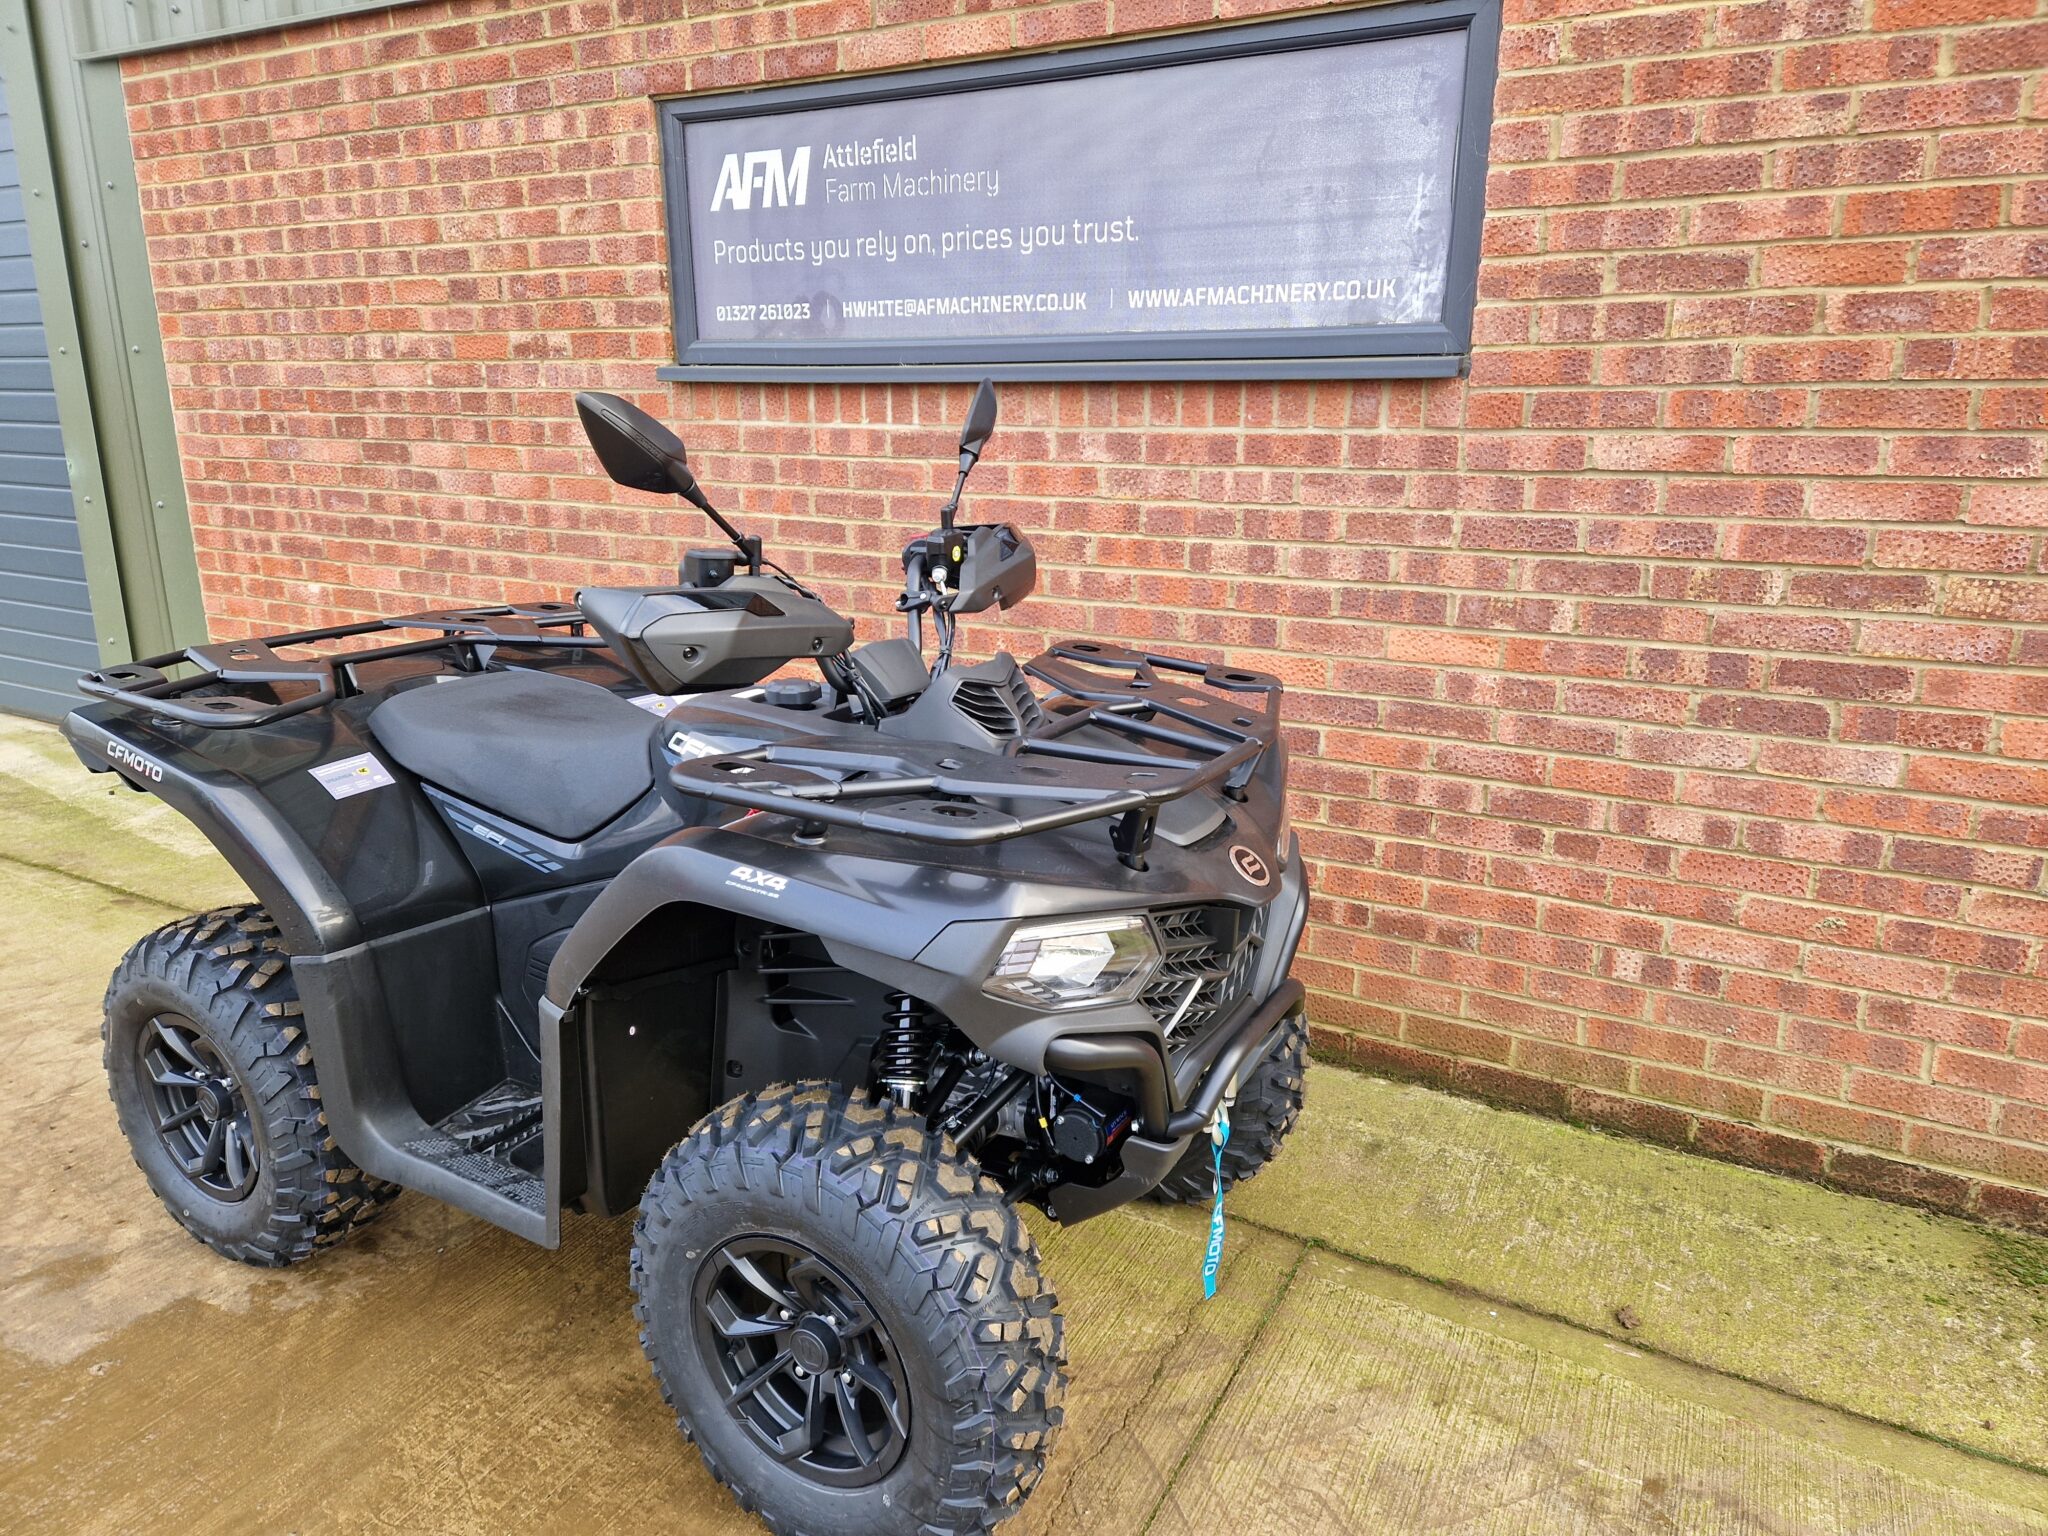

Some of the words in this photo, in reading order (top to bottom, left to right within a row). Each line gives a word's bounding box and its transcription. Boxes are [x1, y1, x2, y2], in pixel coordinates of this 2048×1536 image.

[823, 135, 917, 169] Attlefield
[710, 146, 811, 211] AFM
[825, 178, 876, 203] Farm
[883, 166, 999, 199] Machinery
[713, 239, 805, 264] Products
[811, 239, 850, 265] you
[856, 230, 897, 262] rely
[904, 233, 936, 256] on,
[941, 224, 1013, 258] prices
[1020, 224, 1065, 255] you
[1072, 214, 1139, 244] trust.
[716, 305, 756, 322] 01327
[759, 303, 811, 321] 261023
[842, 293, 1087, 318] HWHITE@AFMACHINERY.CO.UK
[1127, 278, 1396, 309] WWW.AFMACHINERY.CO.UK
[107, 741, 163, 783] CFMOTO
[1204, 1202, 1224, 1277] CFMOTO
